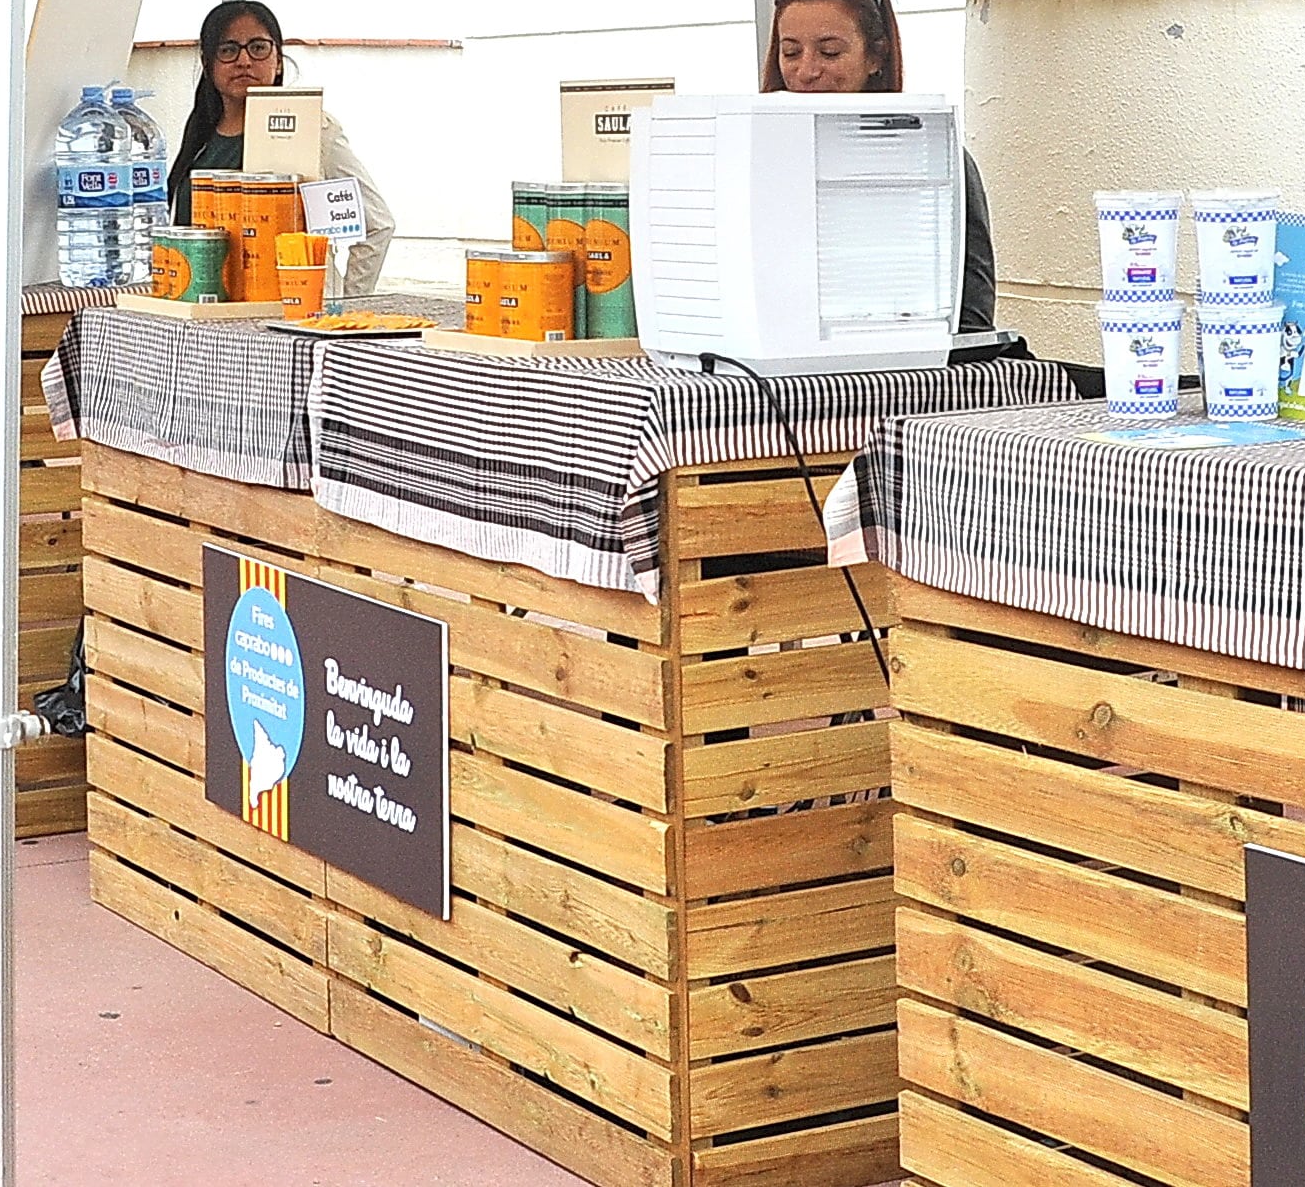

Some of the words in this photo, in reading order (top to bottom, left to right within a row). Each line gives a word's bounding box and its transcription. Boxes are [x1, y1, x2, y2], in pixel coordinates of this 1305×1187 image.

[330, 208, 357, 221] Saula
[251, 605, 275, 629] Fires
[235, 631, 270, 657] caprabo
[230, 657, 242, 675] de
[242, 660, 286, 693] Productes
[287, 679, 299, 699] de
[324, 657, 414, 726] Benvinguda
[241, 685, 287, 720] Proximitat
[326, 709, 344, 749] la
[345, 724, 379, 764] vida
[380, 738, 389, 768] i
[390, 736, 411, 777] la
[327, 773, 374, 813] nostra
[374, 785, 417, 833] terra
